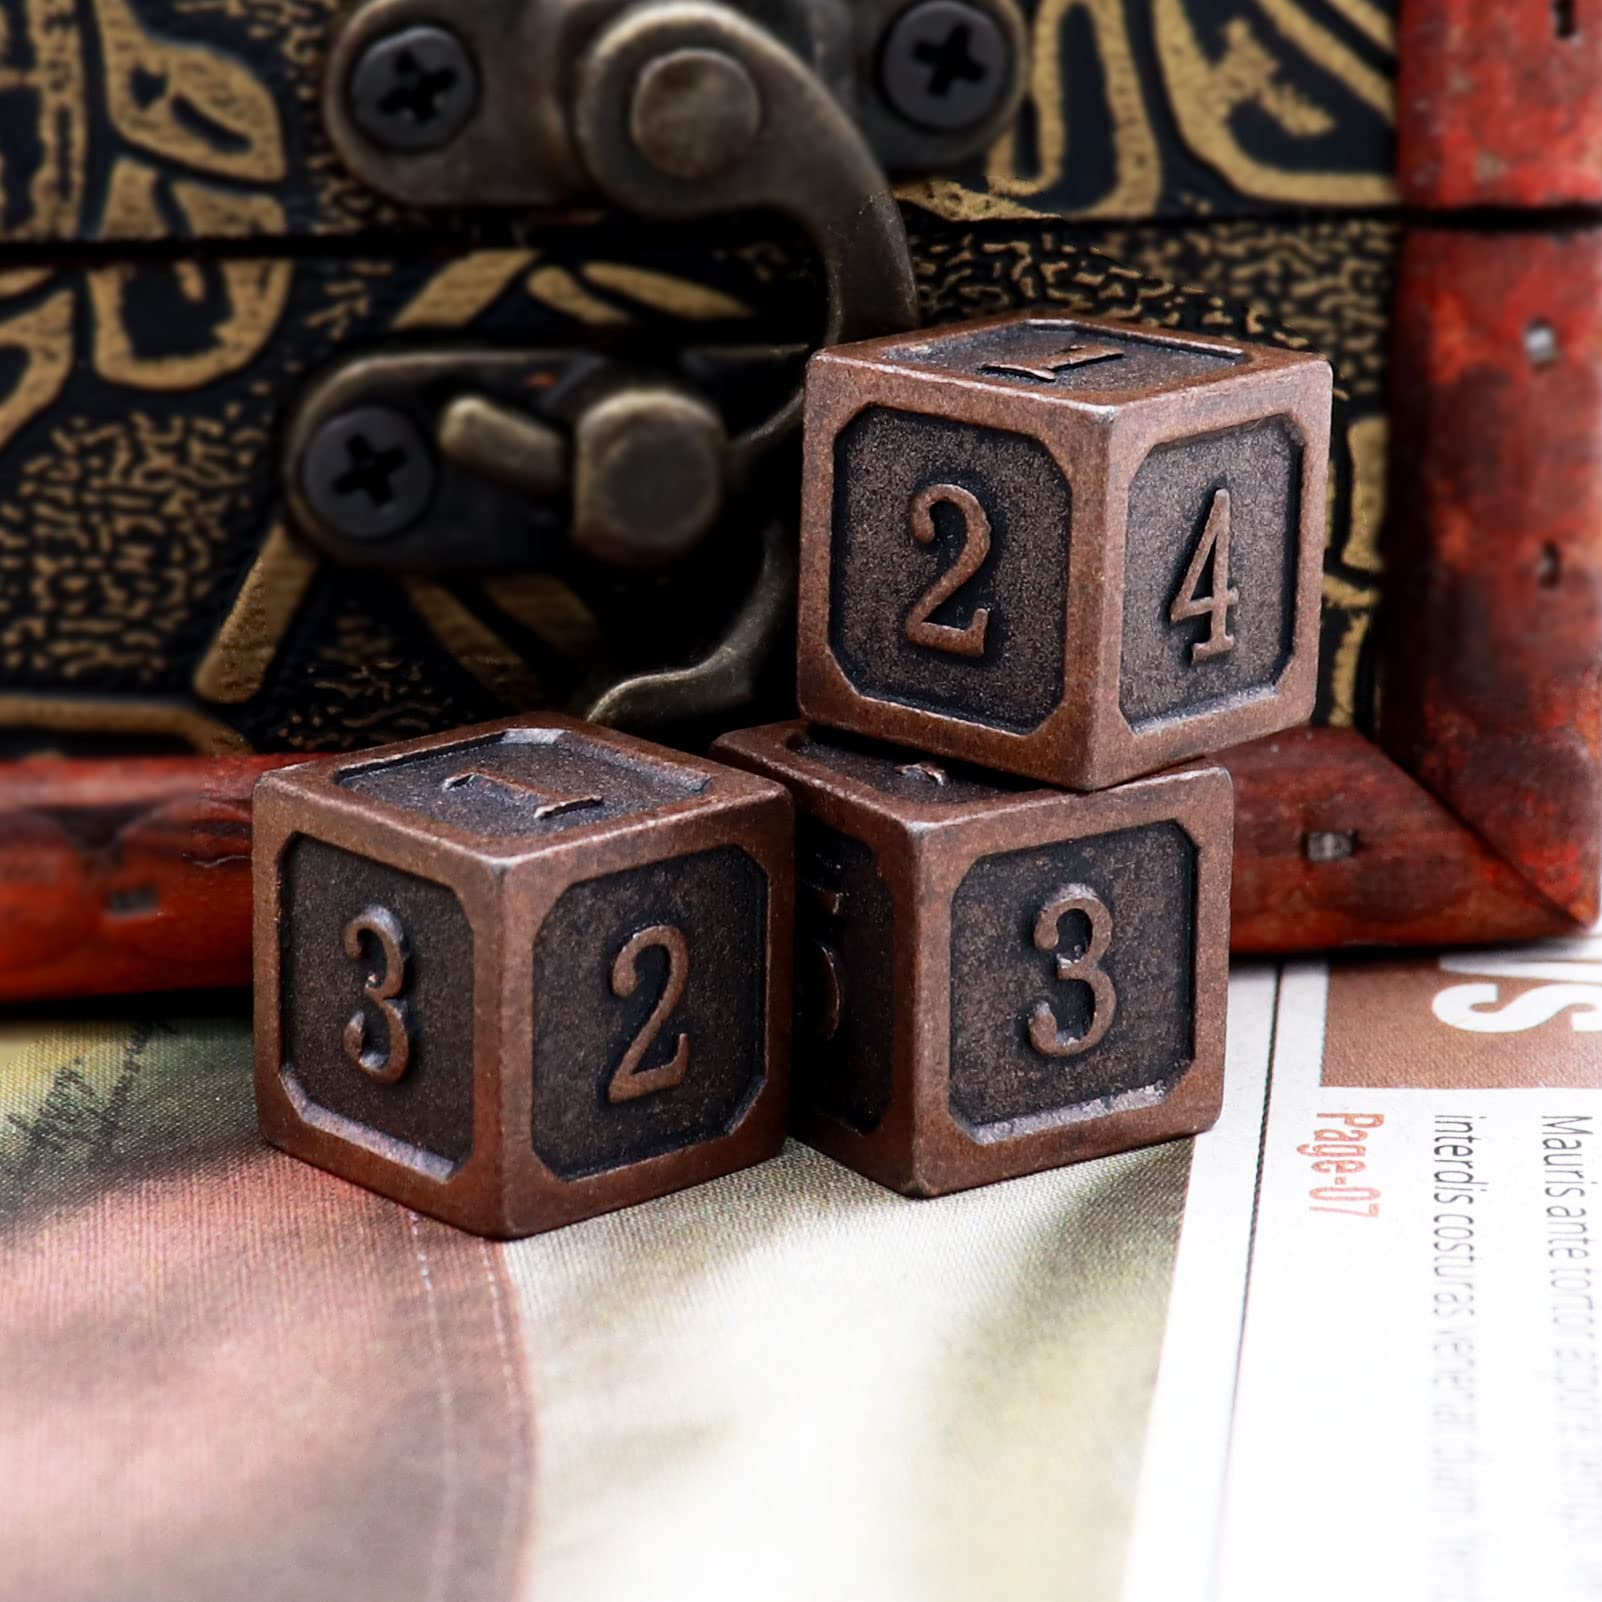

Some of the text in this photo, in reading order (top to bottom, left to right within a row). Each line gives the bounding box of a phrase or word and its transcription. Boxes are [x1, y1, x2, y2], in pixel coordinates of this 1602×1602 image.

[905, 482, 992, 657] 2
[1169, 488, 1239, 664] 4
[343, 903, 409, 1084] 3
[608, 924, 689, 1104] 2
[1028, 882, 1117, 1057] 3
[1296, 1112, 1385, 1218] Page-07
[1433, 1114, 1490, 1205] interdis
[1541, 1115, 1599, 1198] Mauris
[1432, 1213, 1482, 1317] costuras
[1545, 1205, 1599, 1259] ante
